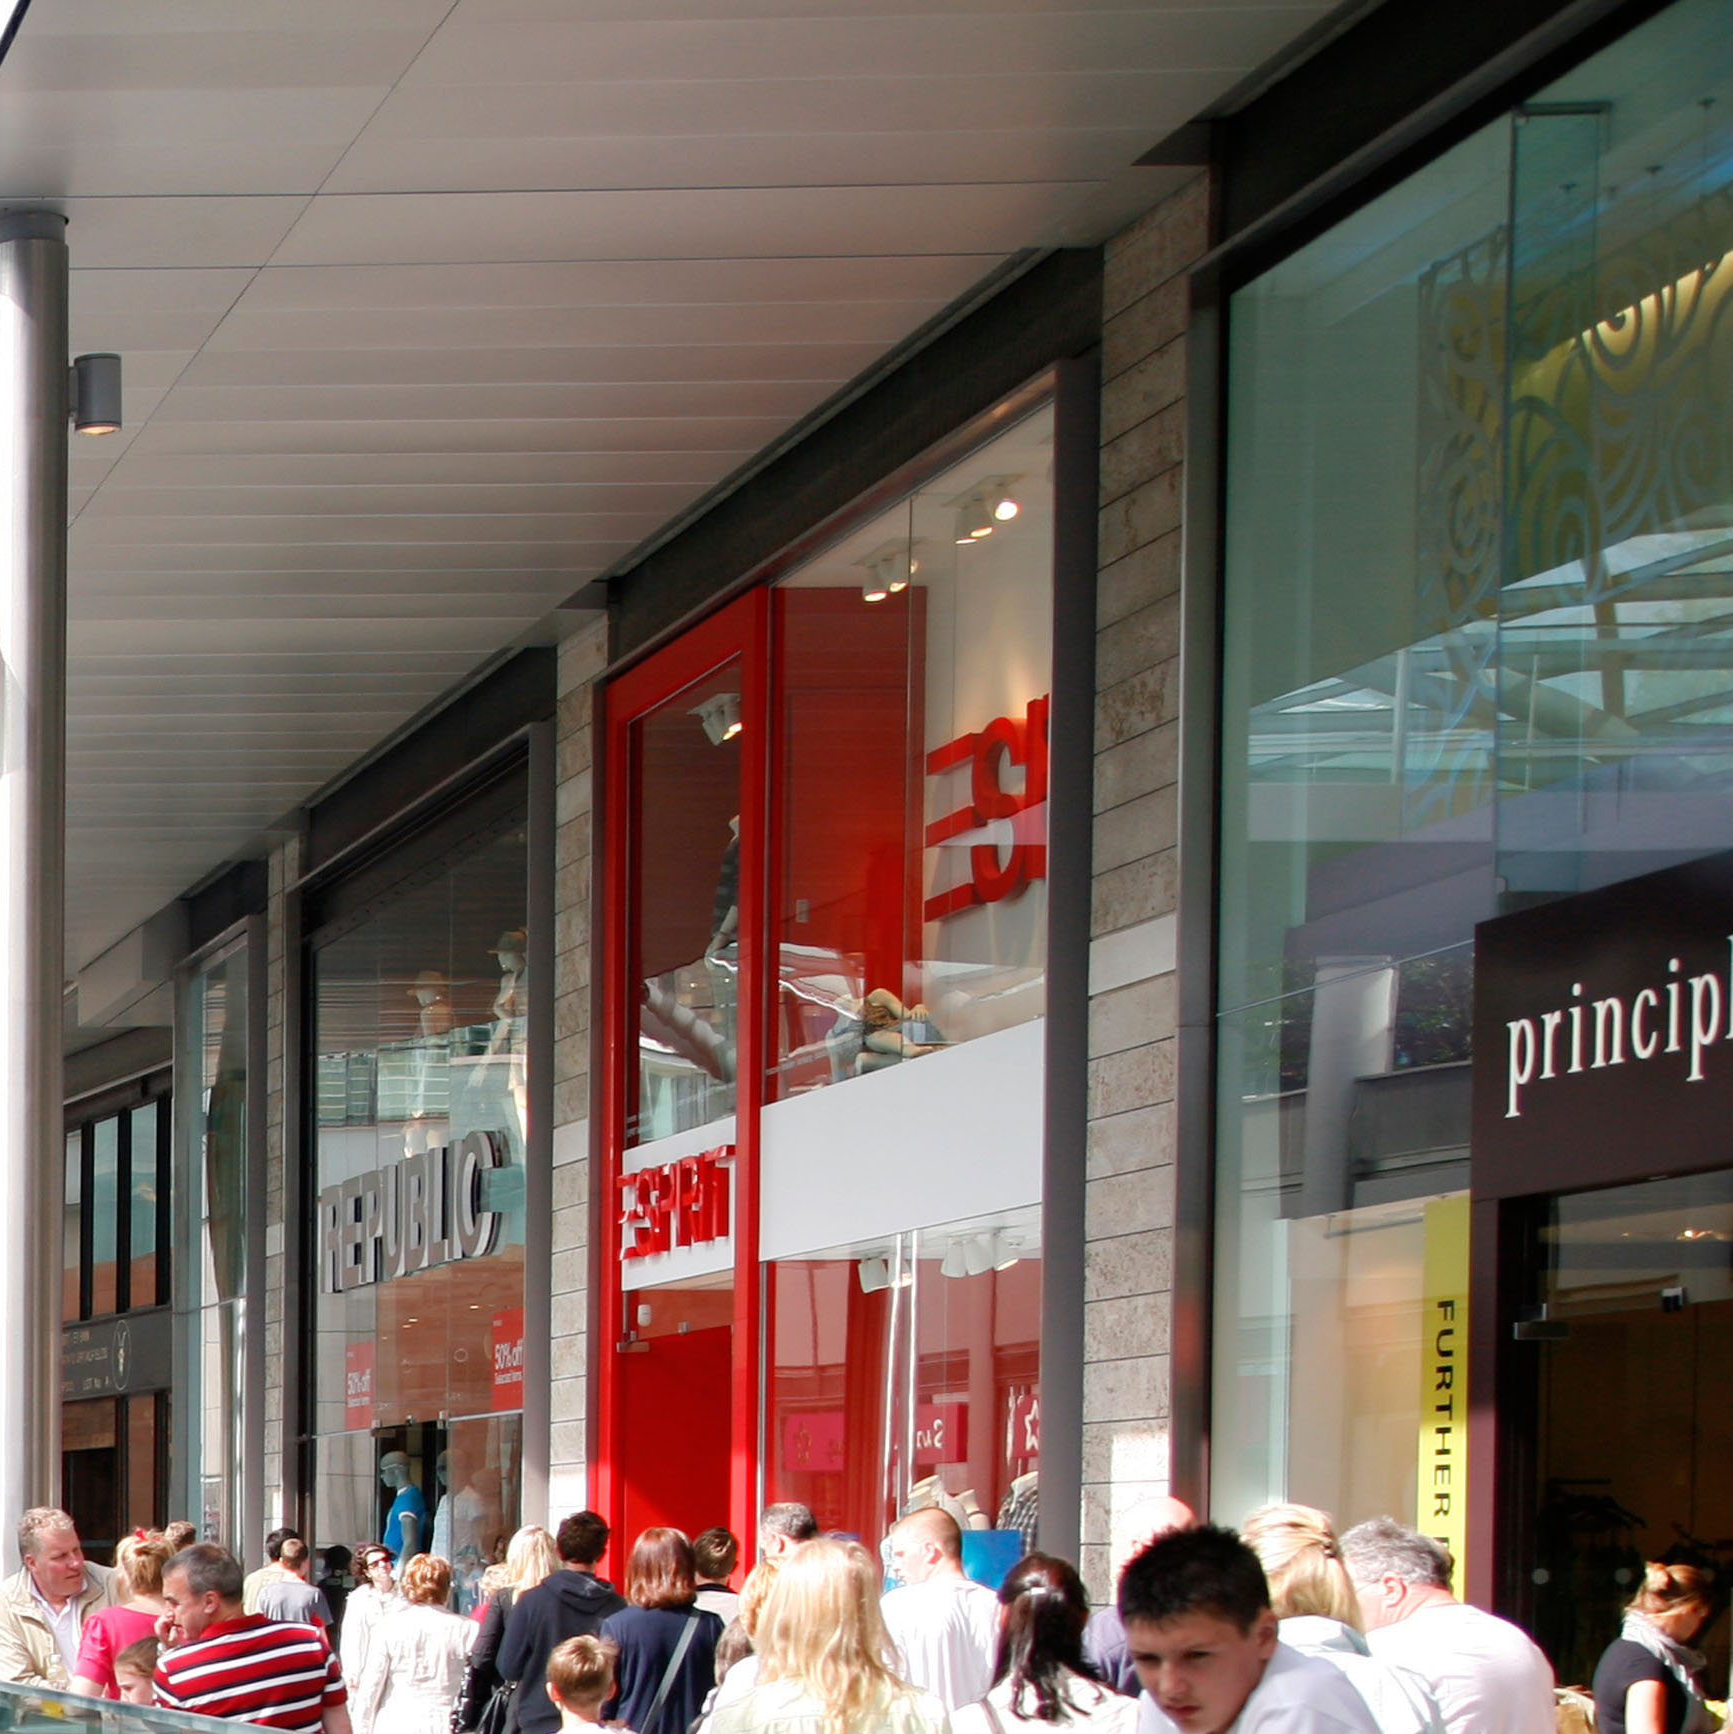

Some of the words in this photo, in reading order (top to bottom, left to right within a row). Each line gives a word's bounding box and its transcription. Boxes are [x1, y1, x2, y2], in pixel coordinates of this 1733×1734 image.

[321, 1131, 499, 1293] REPUBLIC
[616, 1145, 735, 1260] ESPRIT
[1433, 1300, 1454, 1517] FURTHER
